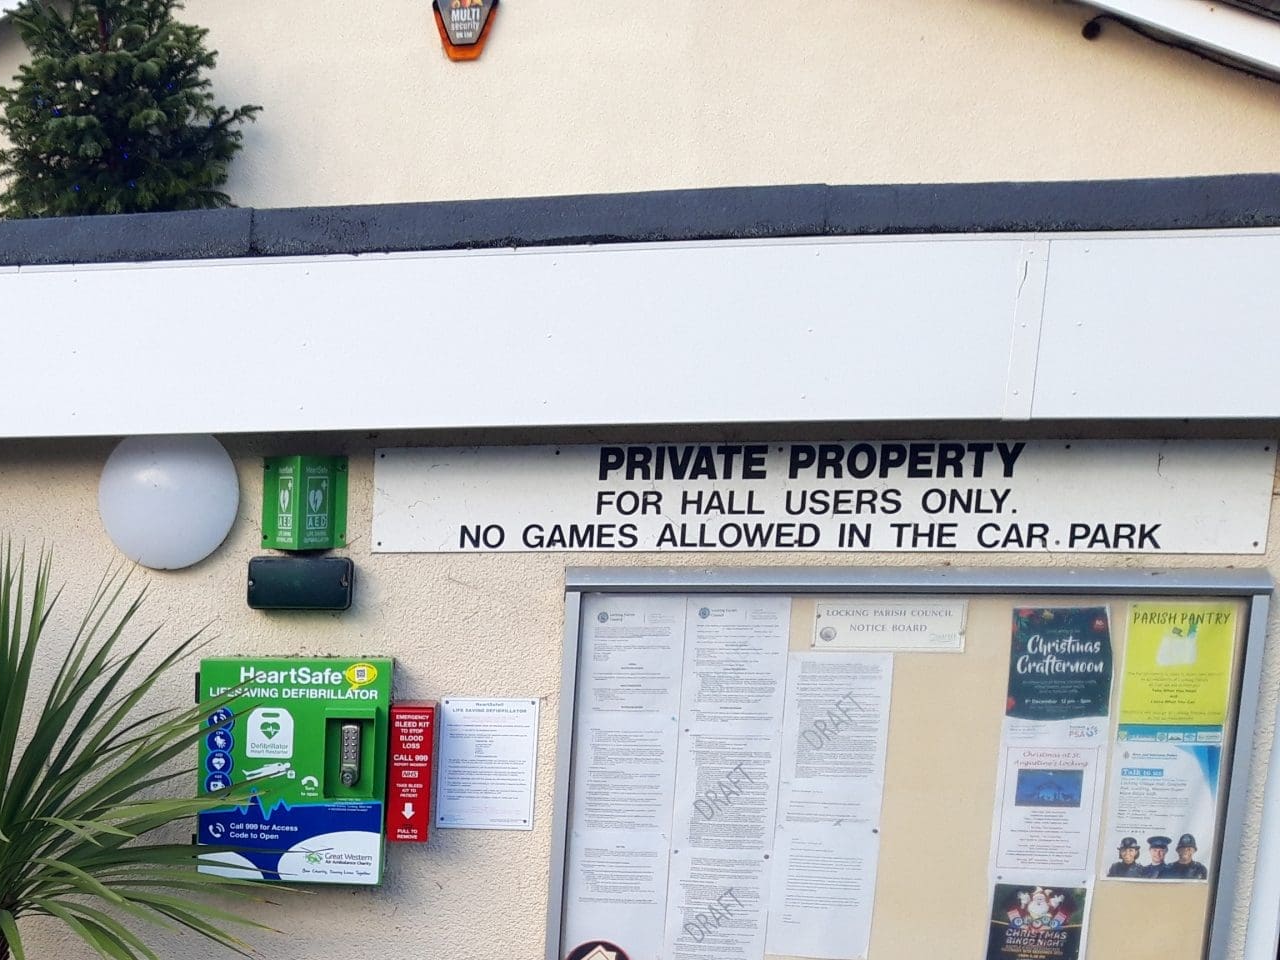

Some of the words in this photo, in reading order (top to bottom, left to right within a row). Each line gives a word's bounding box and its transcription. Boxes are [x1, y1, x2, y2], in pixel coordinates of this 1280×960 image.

[451, 8, 480, 21] MULTI
[598, 445, 769, 481] PRIVATE
[788, 443, 1026, 479] PROPERTY
[596, 490, 663, 515] FOR
[681, 490, 765, 515] HALL
[785, 489, 902, 515] USERS
[921, 488, 1017, 514] ONLY.
[460, 524, 505, 548] NO
[522, 524, 638, 548] GAMES
[656, 523, 820, 548] ALLOWED
[838, 523, 871, 548] IN
[890, 523, 958, 548] THE
[1070, 523, 1161, 549] PARK
[826, 609, 869, 617] LOCKING
[873, 609, 907, 617] PARISH
[911, 609, 953, 617] COUNCIL
[1133, 612, 1177, 625] PARISH
[1181, 612, 1231, 625] PANTRY
[849, 624, 887, 632] NOTICE
[891, 624, 928, 632] BOARD
[1027, 634, 1101, 656] Christmas
[1016, 655, 1105, 675] Crafternoon
[240, 666, 343, 684] HeartSafe
[282, 688, 378, 700] DEFIBRILLATOR
[802, 691, 865, 750] DRAFT
[250, 742, 289, 750] Defibrillator
[693, 763, 755, 820] DRAFT
[229, 822, 244, 830] Call
[271, 824, 298, 832] Access
[250, 832, 258, 840] to
[324, 852, 343, 860] Great
[344, 853, 373, 862] Western
[683, 888, 745, 943] DRAFT
[1005, 928, 1068, 940] CHRISTMAS
